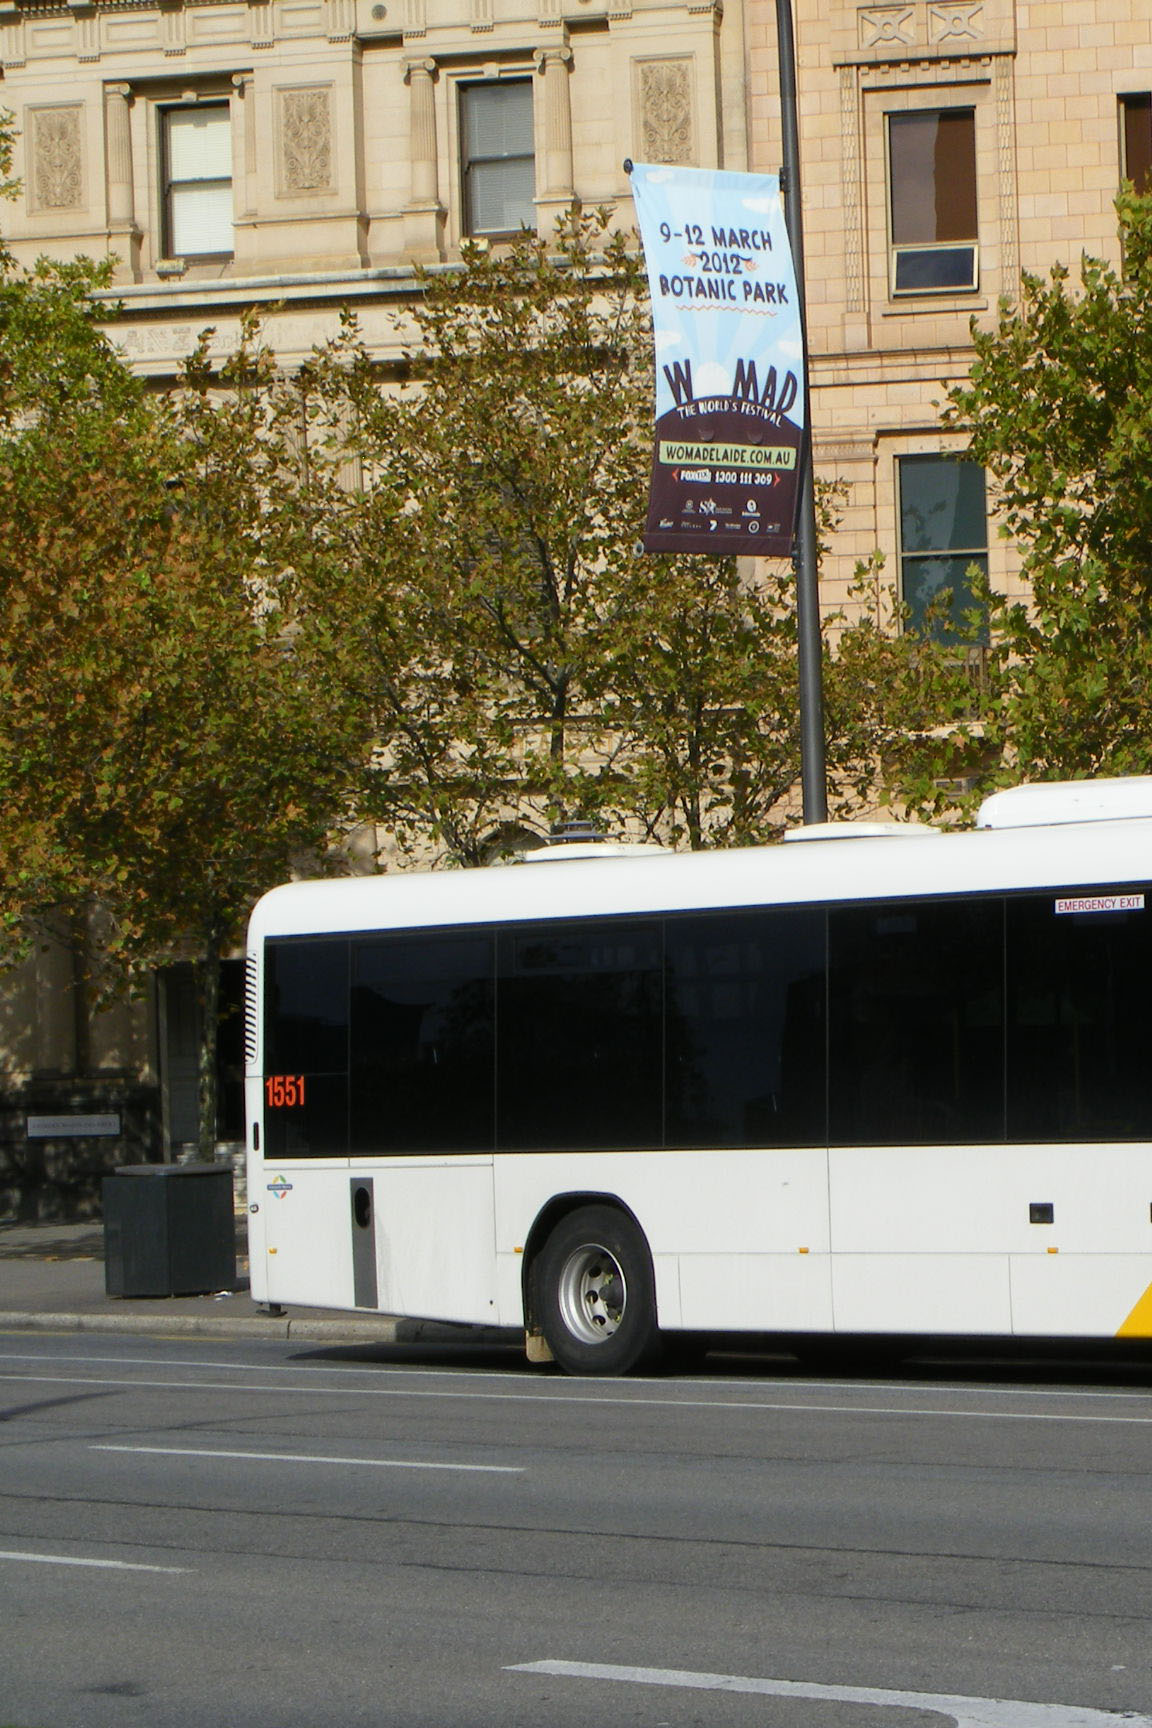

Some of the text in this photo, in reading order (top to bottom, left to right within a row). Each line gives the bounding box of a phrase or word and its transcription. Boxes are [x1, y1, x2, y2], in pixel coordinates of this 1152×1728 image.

[659, 222, 773, 251] 9-12 MARCH
[700, 250, 744, 275] 2012
[659, 274, 789, 304] BOTANIC PARK
[677, 400, 782, 428] THE WORLD'S FESTIVAL
[666, 445, 791, 466] WOMADELAIDE.COM.AU
[715, 470, 737, 484] 1300
[740, 472, 752, 484] 111
[754, 473, 773, 486] 369
[1058, 896, 1141, 912] EMERGENCY EXIT
[265, 1075, 305, 1107] 1551
